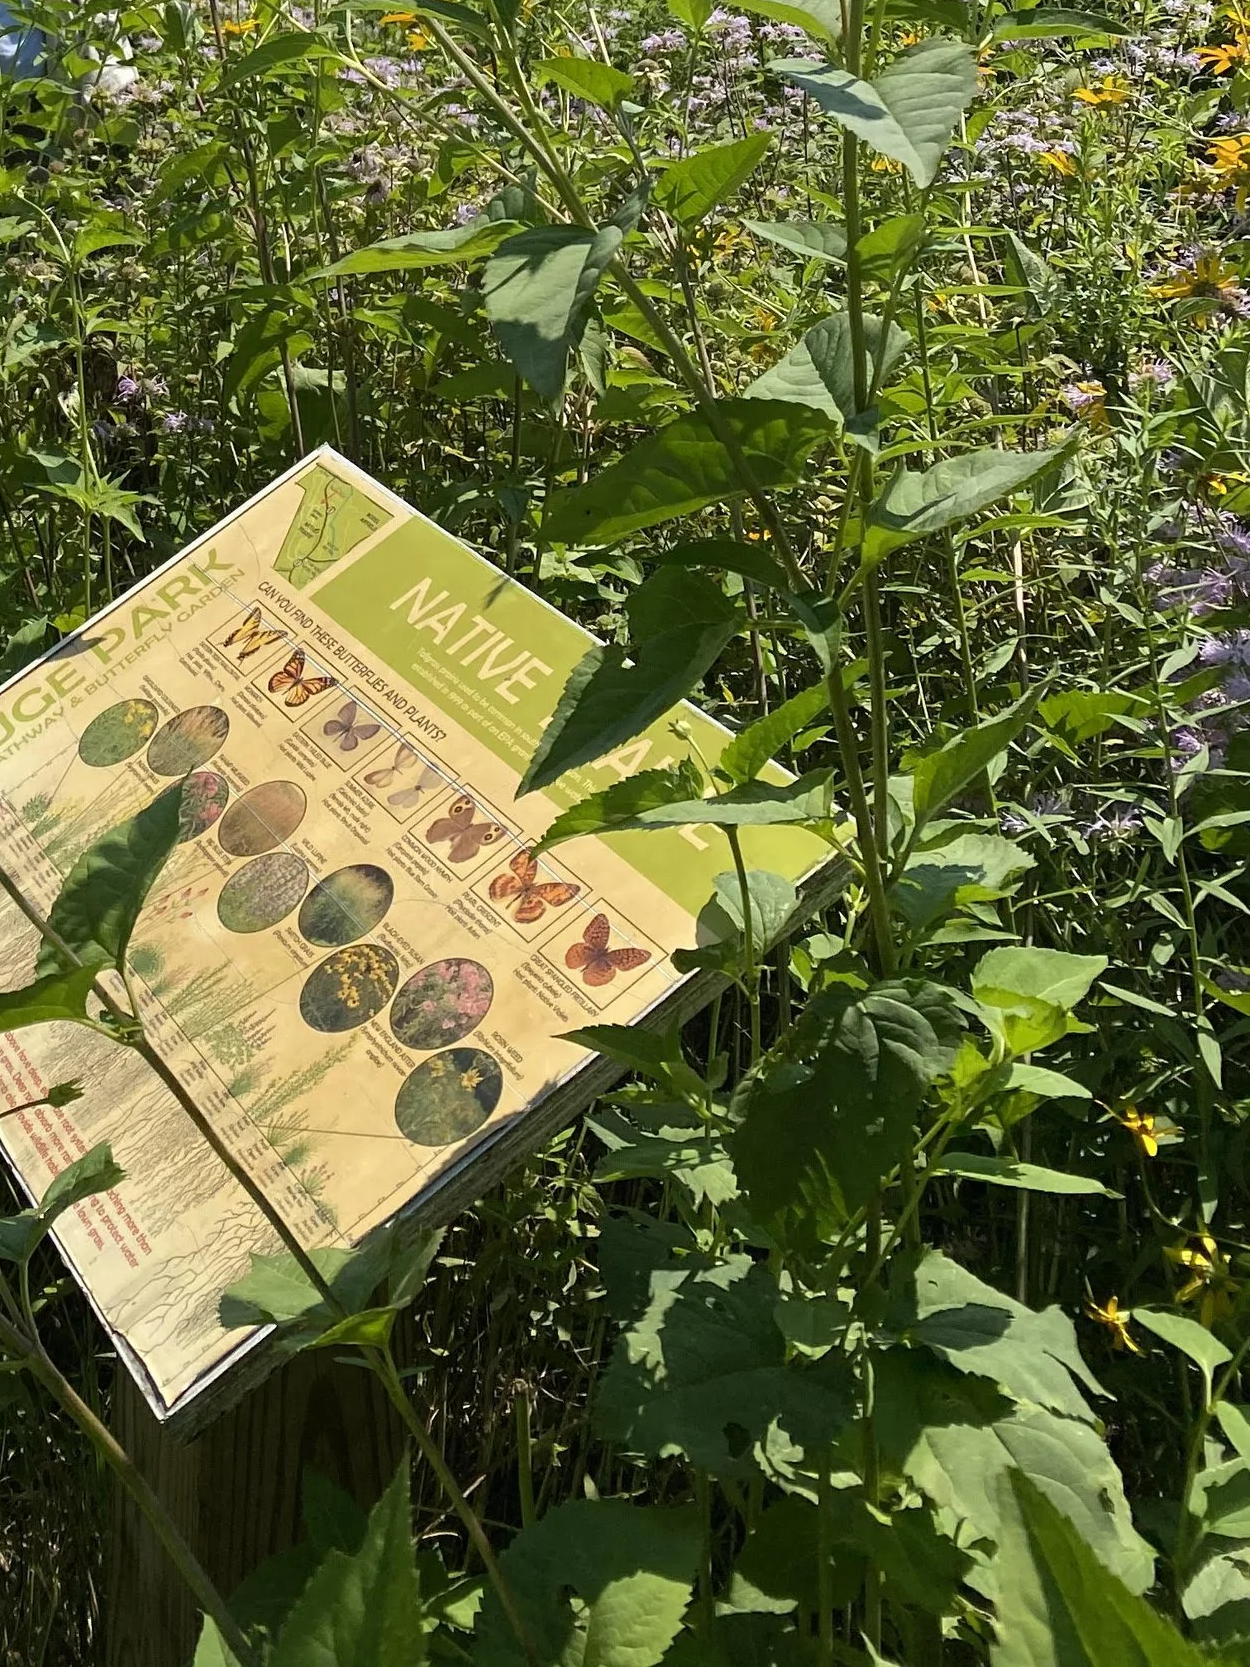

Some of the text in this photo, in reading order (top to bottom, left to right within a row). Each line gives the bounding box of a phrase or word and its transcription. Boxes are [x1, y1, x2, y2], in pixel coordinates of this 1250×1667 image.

[66, 692, 84, 709] &
[82, 620, 178, 696] BUTTERFLY
[173, 567, 247, 625] GARDEN
[85, 546, 236, 665] PARK
[256, 579, 448, 744] CAN YOU FIND THESE BUTTERFLIES AND PLANTS?
[388, 575, 556, 706] NATIVE
[477, 696, 492, 708] be
[47, 1130, 65, 1153] more
[75, 1205, 95, 1230] lawn
[94, 1204, 140, 1271] to protect water
[120, 1211, 140, 1237] more
[134, 1231, 155, 1257] than
